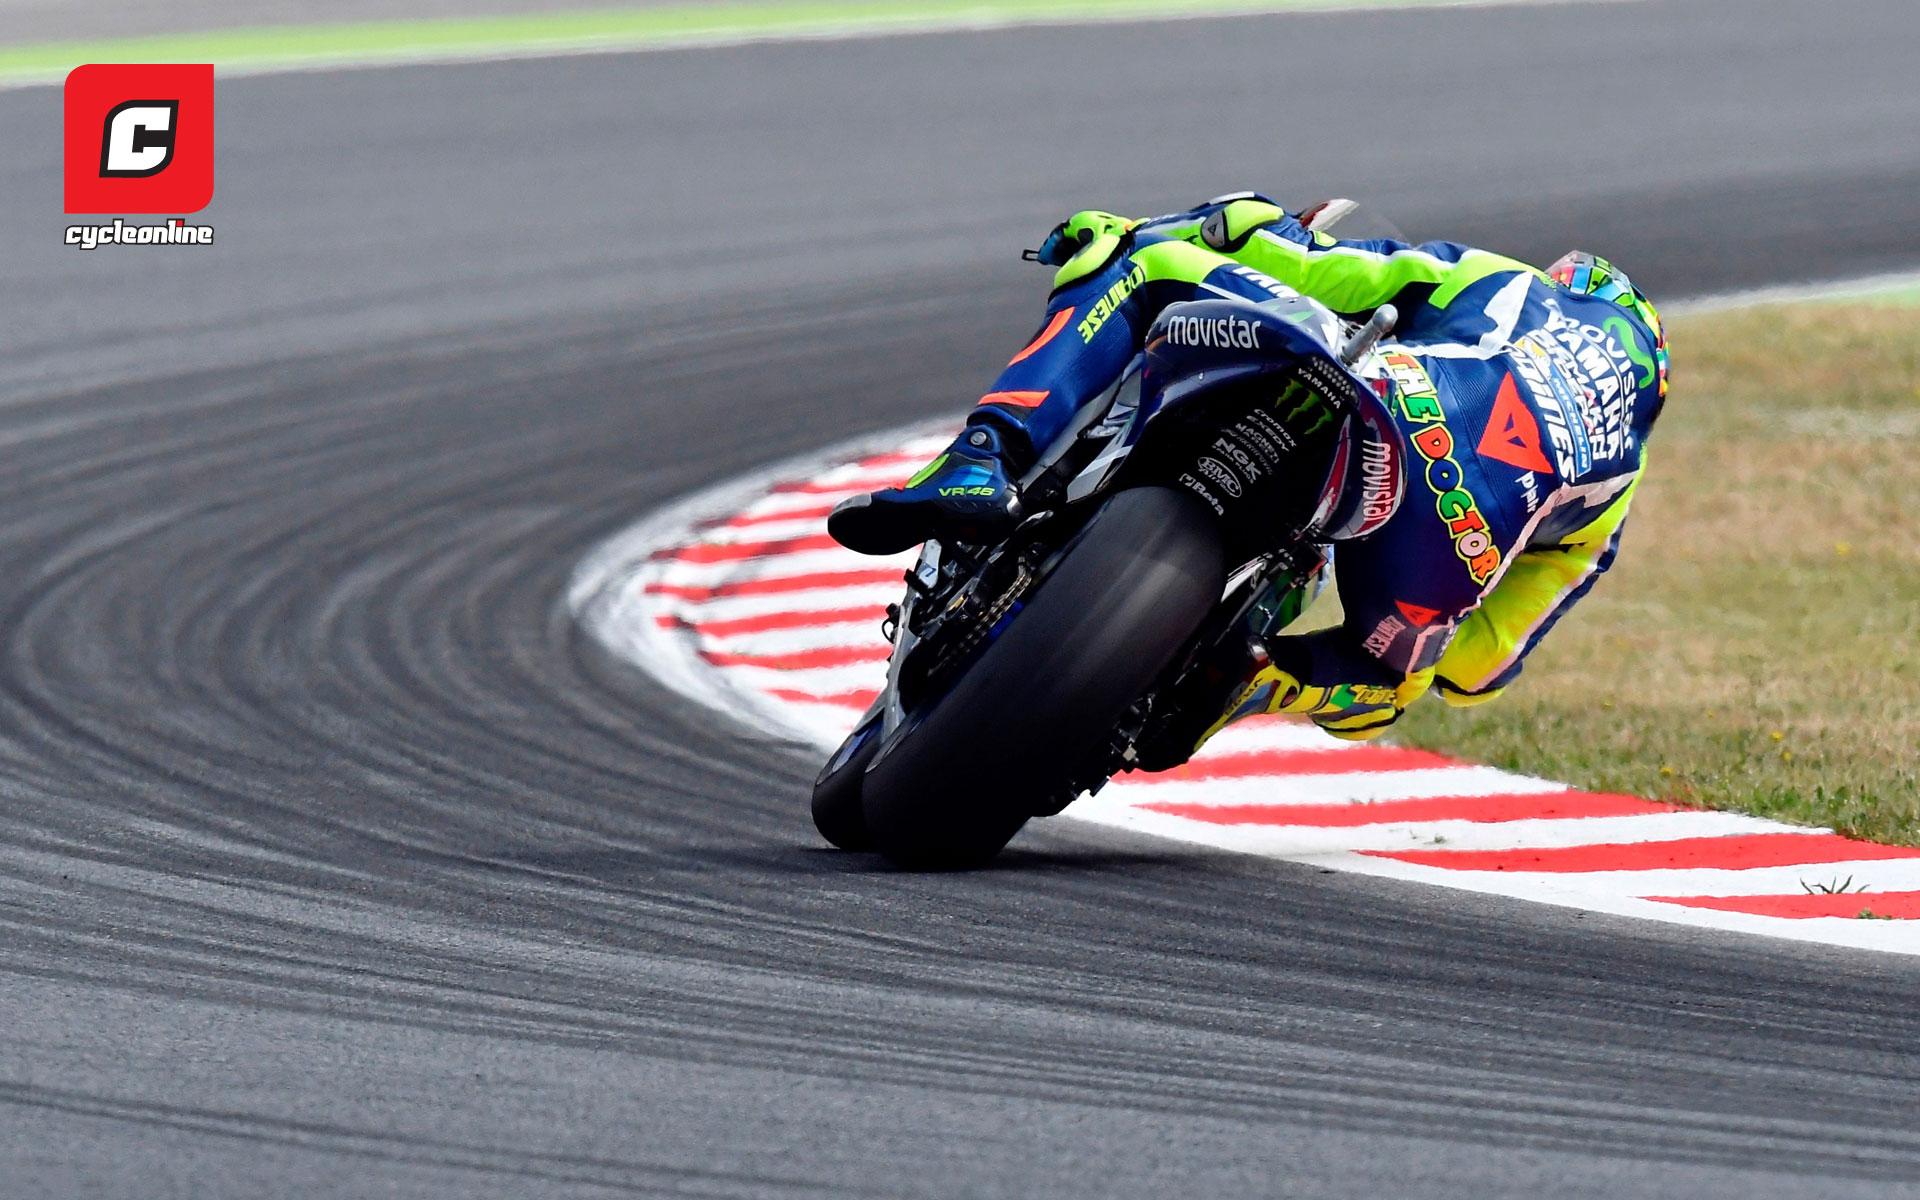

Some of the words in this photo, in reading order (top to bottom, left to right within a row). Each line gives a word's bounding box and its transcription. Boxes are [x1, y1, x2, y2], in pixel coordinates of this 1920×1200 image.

[1167, 315, 1261, 349] movistar
[1298, 368, 1341, 409] YAMAHA
[1384, 353, 1442, 421] THE
[1544, 308, 1621, 461] YAMAHA
[1246, 415, 1290, 452] EXEDY
[1199, 460, 1240, 493] BMC
[1215, 437, 1262, 481] NGK
[1362, 440, 1395, 521] movistar
[1412, 424, 1499, 583] DOCTOR
